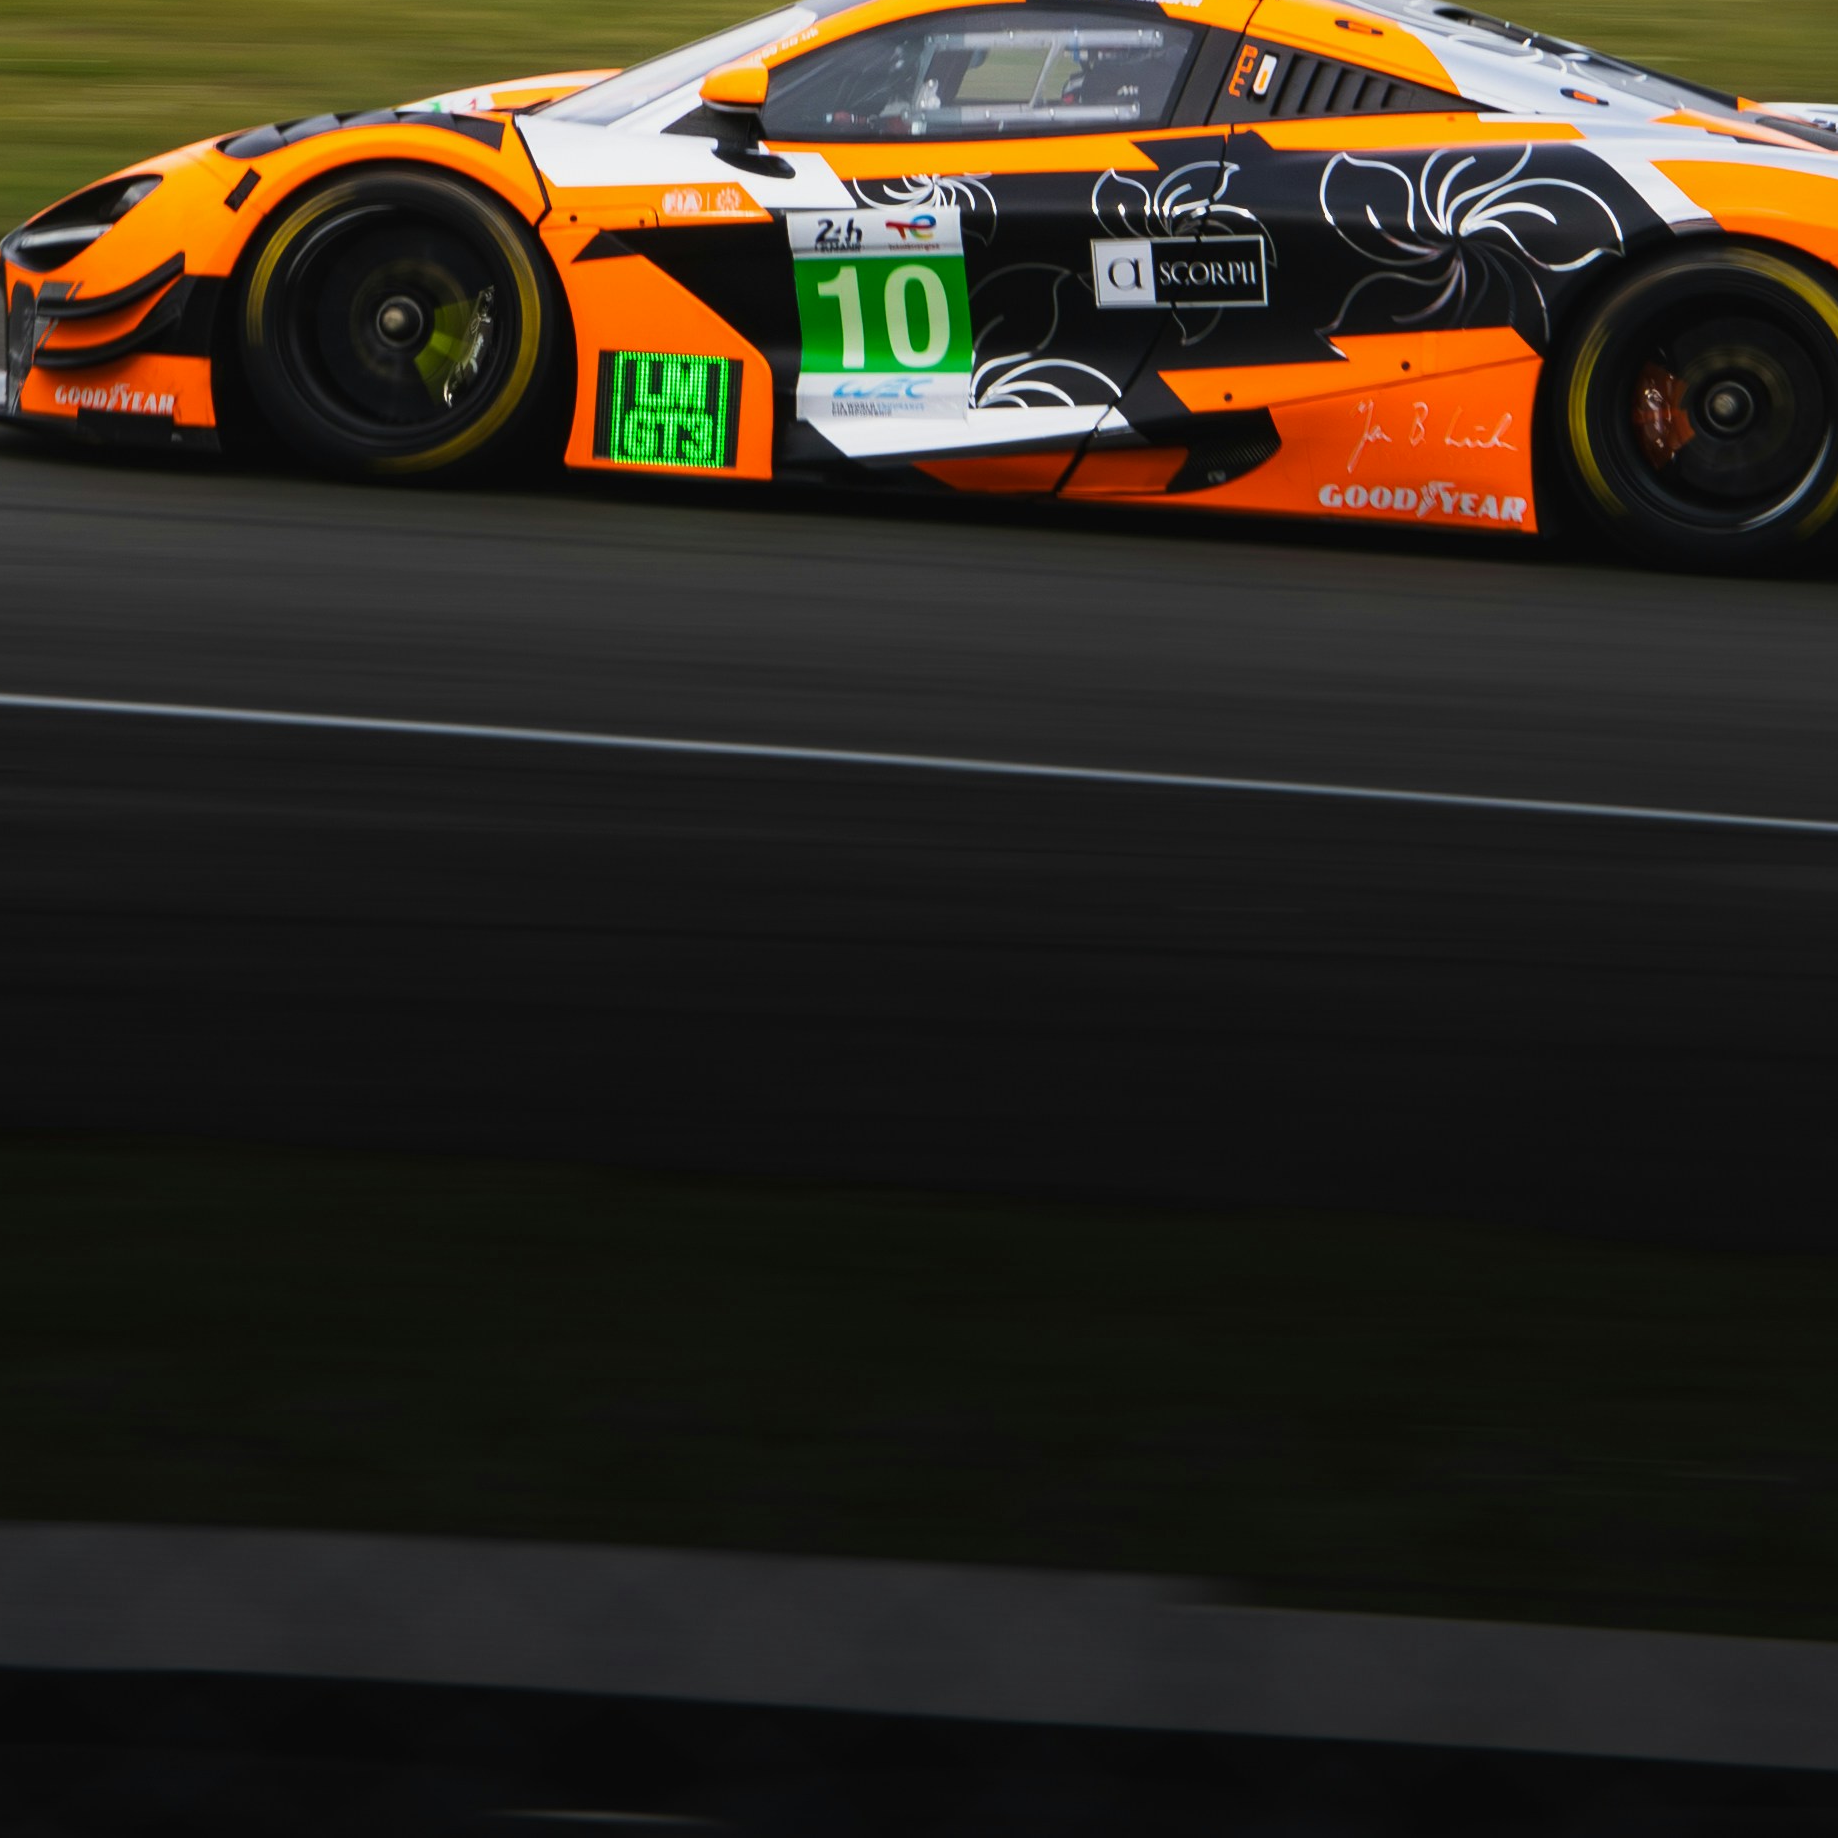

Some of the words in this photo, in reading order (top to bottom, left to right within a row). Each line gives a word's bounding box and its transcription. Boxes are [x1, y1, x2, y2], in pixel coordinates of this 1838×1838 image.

[817, 263, 951, 370] 10
[54, 382, 175, 415] GOODYEAR
[634, 360, 709, 408] LM
[623, 407, 714, 459] GT3
[1318, 479, 1528, 523] GOODYEAR
